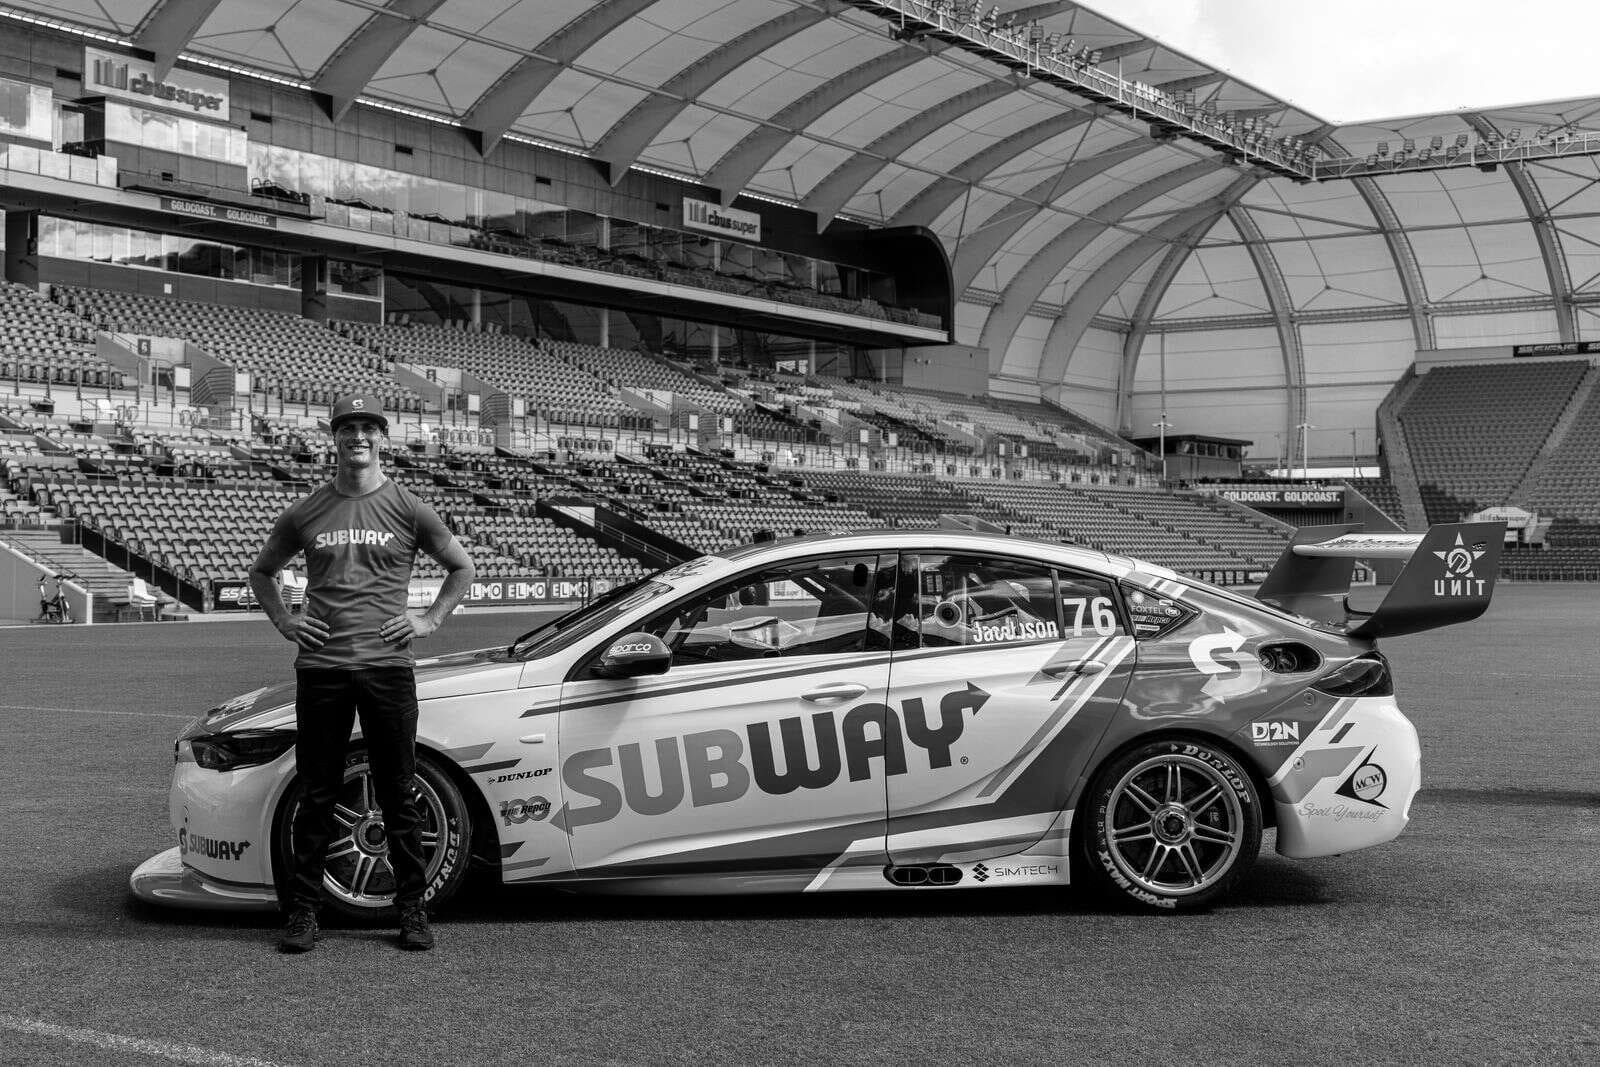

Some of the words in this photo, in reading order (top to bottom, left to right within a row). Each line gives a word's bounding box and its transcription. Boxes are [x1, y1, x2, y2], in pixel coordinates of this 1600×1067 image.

[1283, 491, 1340, 502] GOLDCOAST.
[314, 528, 395, 549] SUBWAY
[507, 582, 546, 599] ELMO
[1063, 596, 1116, 637] 76
[608, 643, 652, 657] sparco
[1252, 721, 1300, 741] D2N
[550, 681, 991, 836] SUBWAY
[497, 768, 552, 783] DUNLOP
[1355, 773, 1381, 790] MCW
[189, 834, 251, 861] SUBWAY
[419, 831, 460, 903] DUNLO
[994, 864, 1058, 877] SIMTECH
